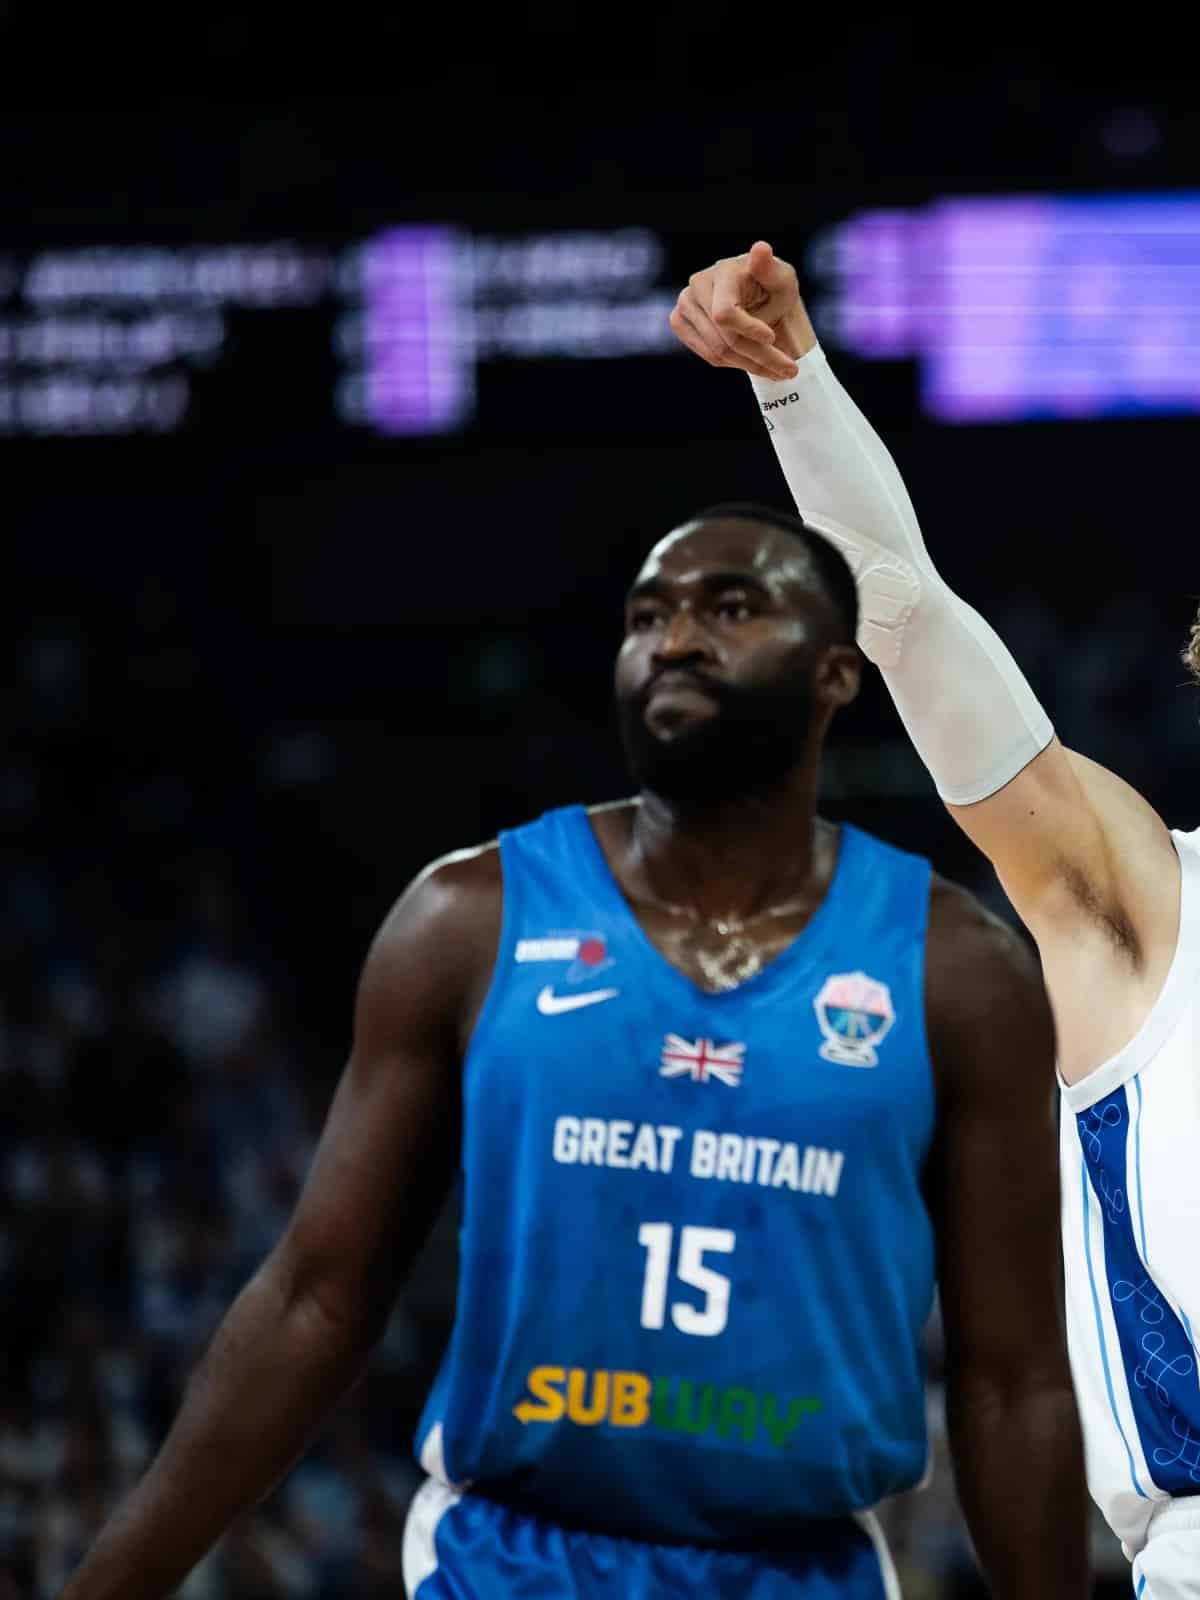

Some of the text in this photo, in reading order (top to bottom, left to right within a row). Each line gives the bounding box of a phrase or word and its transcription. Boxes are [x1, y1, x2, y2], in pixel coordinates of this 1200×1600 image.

[553, 1116, 845, 1197] GREAT BRITAIN
[638, 1222, 736, 1337] 15
[512, 1365, 826, 1448] SUBWAY
